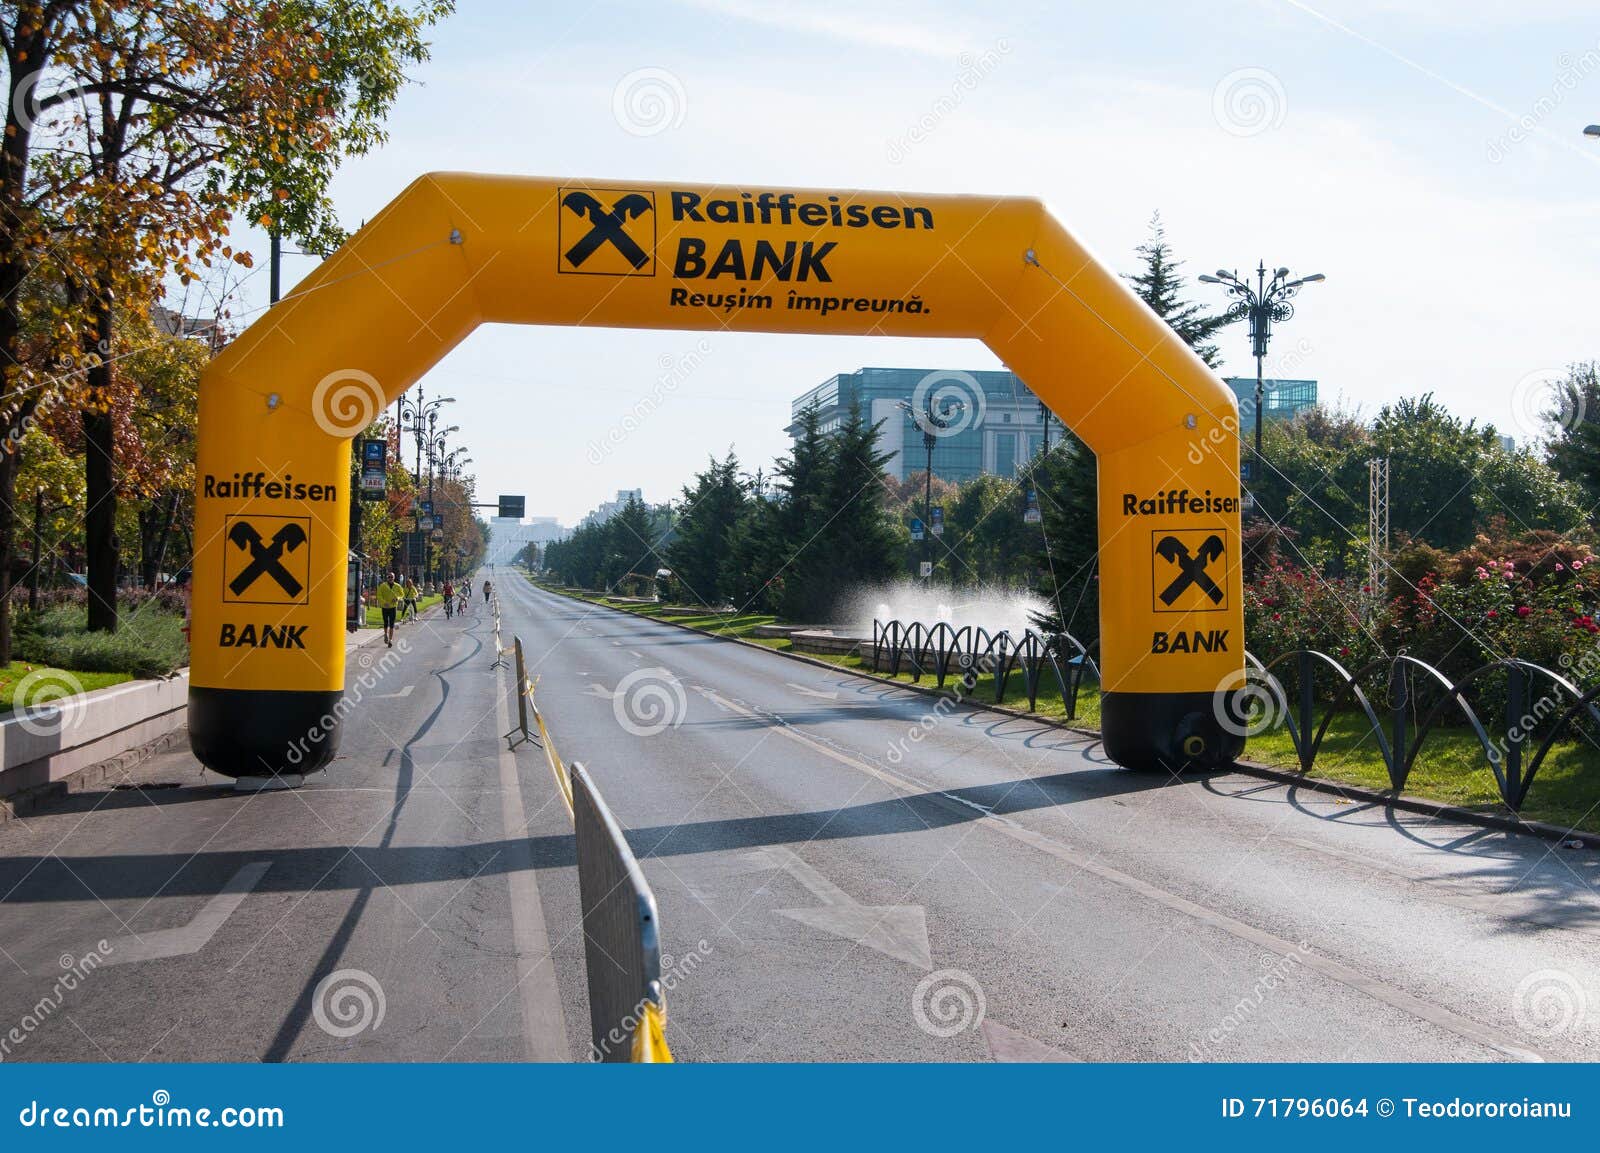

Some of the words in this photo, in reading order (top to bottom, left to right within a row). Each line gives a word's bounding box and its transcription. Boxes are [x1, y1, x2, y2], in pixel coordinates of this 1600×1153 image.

[671, 191, 935, 230] Raiffeisen
[673, 237, 839, 283] BANK
[669, 286, 773, 314] Reușim
[786, 289, 931, 317] împreună.
[203, 472, 337, 502] Raiffeisen
[1122, 489, 1240, 516] Raiffeisen
[219, 623, 309, 650] BANK
[1151, 629, 1230, 655] BANK
